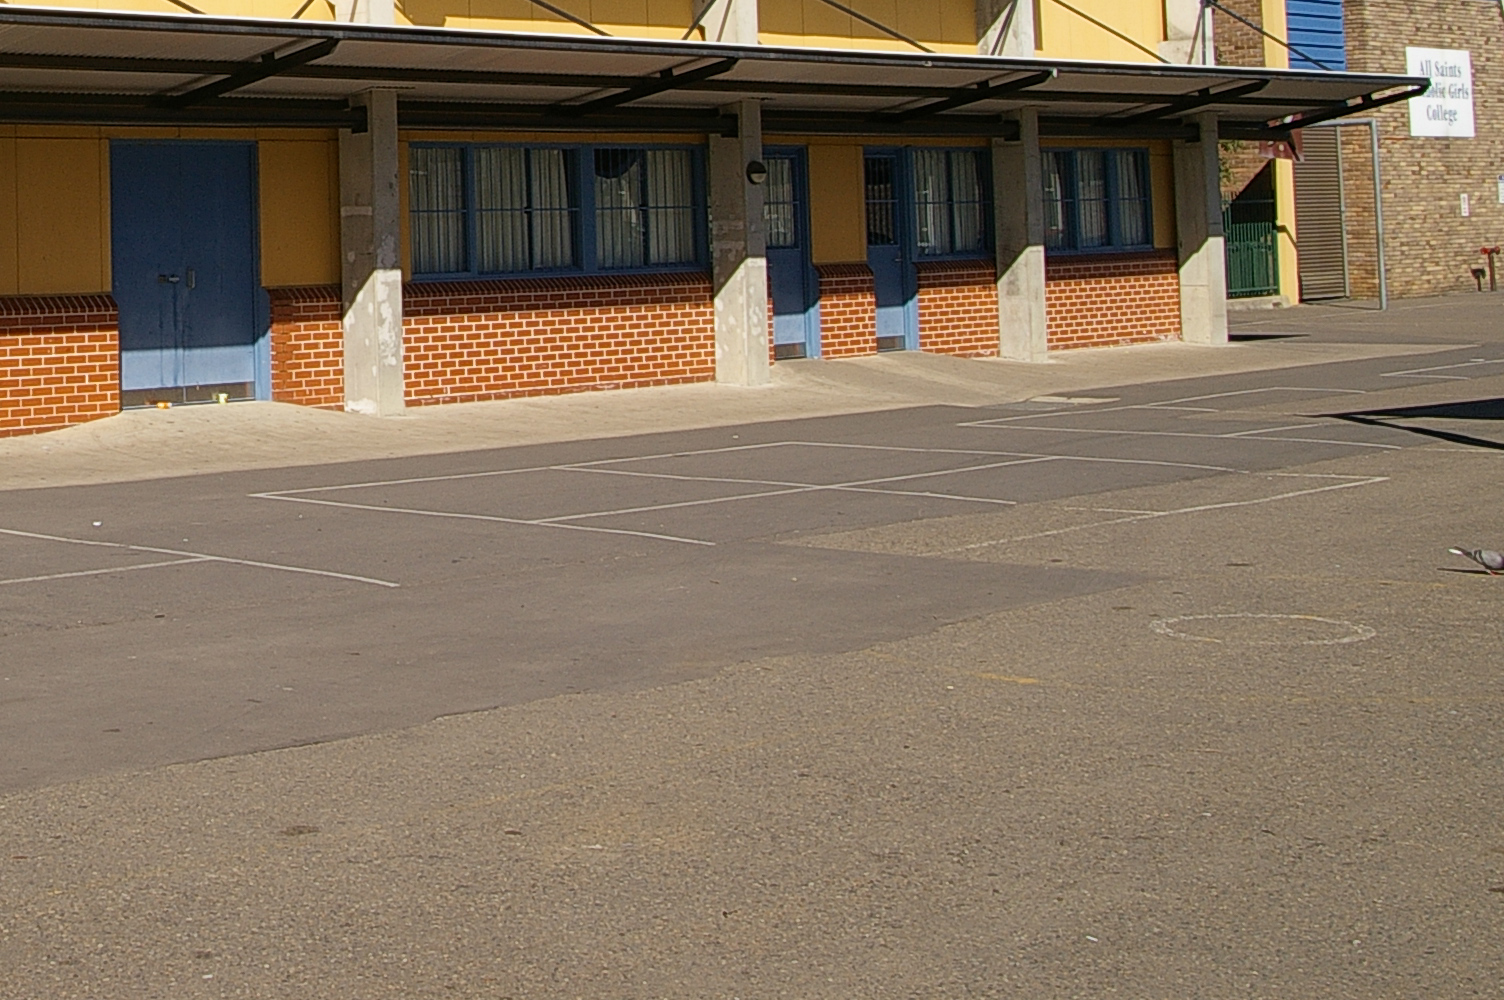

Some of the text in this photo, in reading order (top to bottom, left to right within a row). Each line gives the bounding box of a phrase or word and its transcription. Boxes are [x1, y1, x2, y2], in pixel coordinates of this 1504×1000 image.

[1419, 60, 1462, 78] All Saints
[1448, 83, 1469, 100] Girls
[1426, 104, 1458, 126] College
